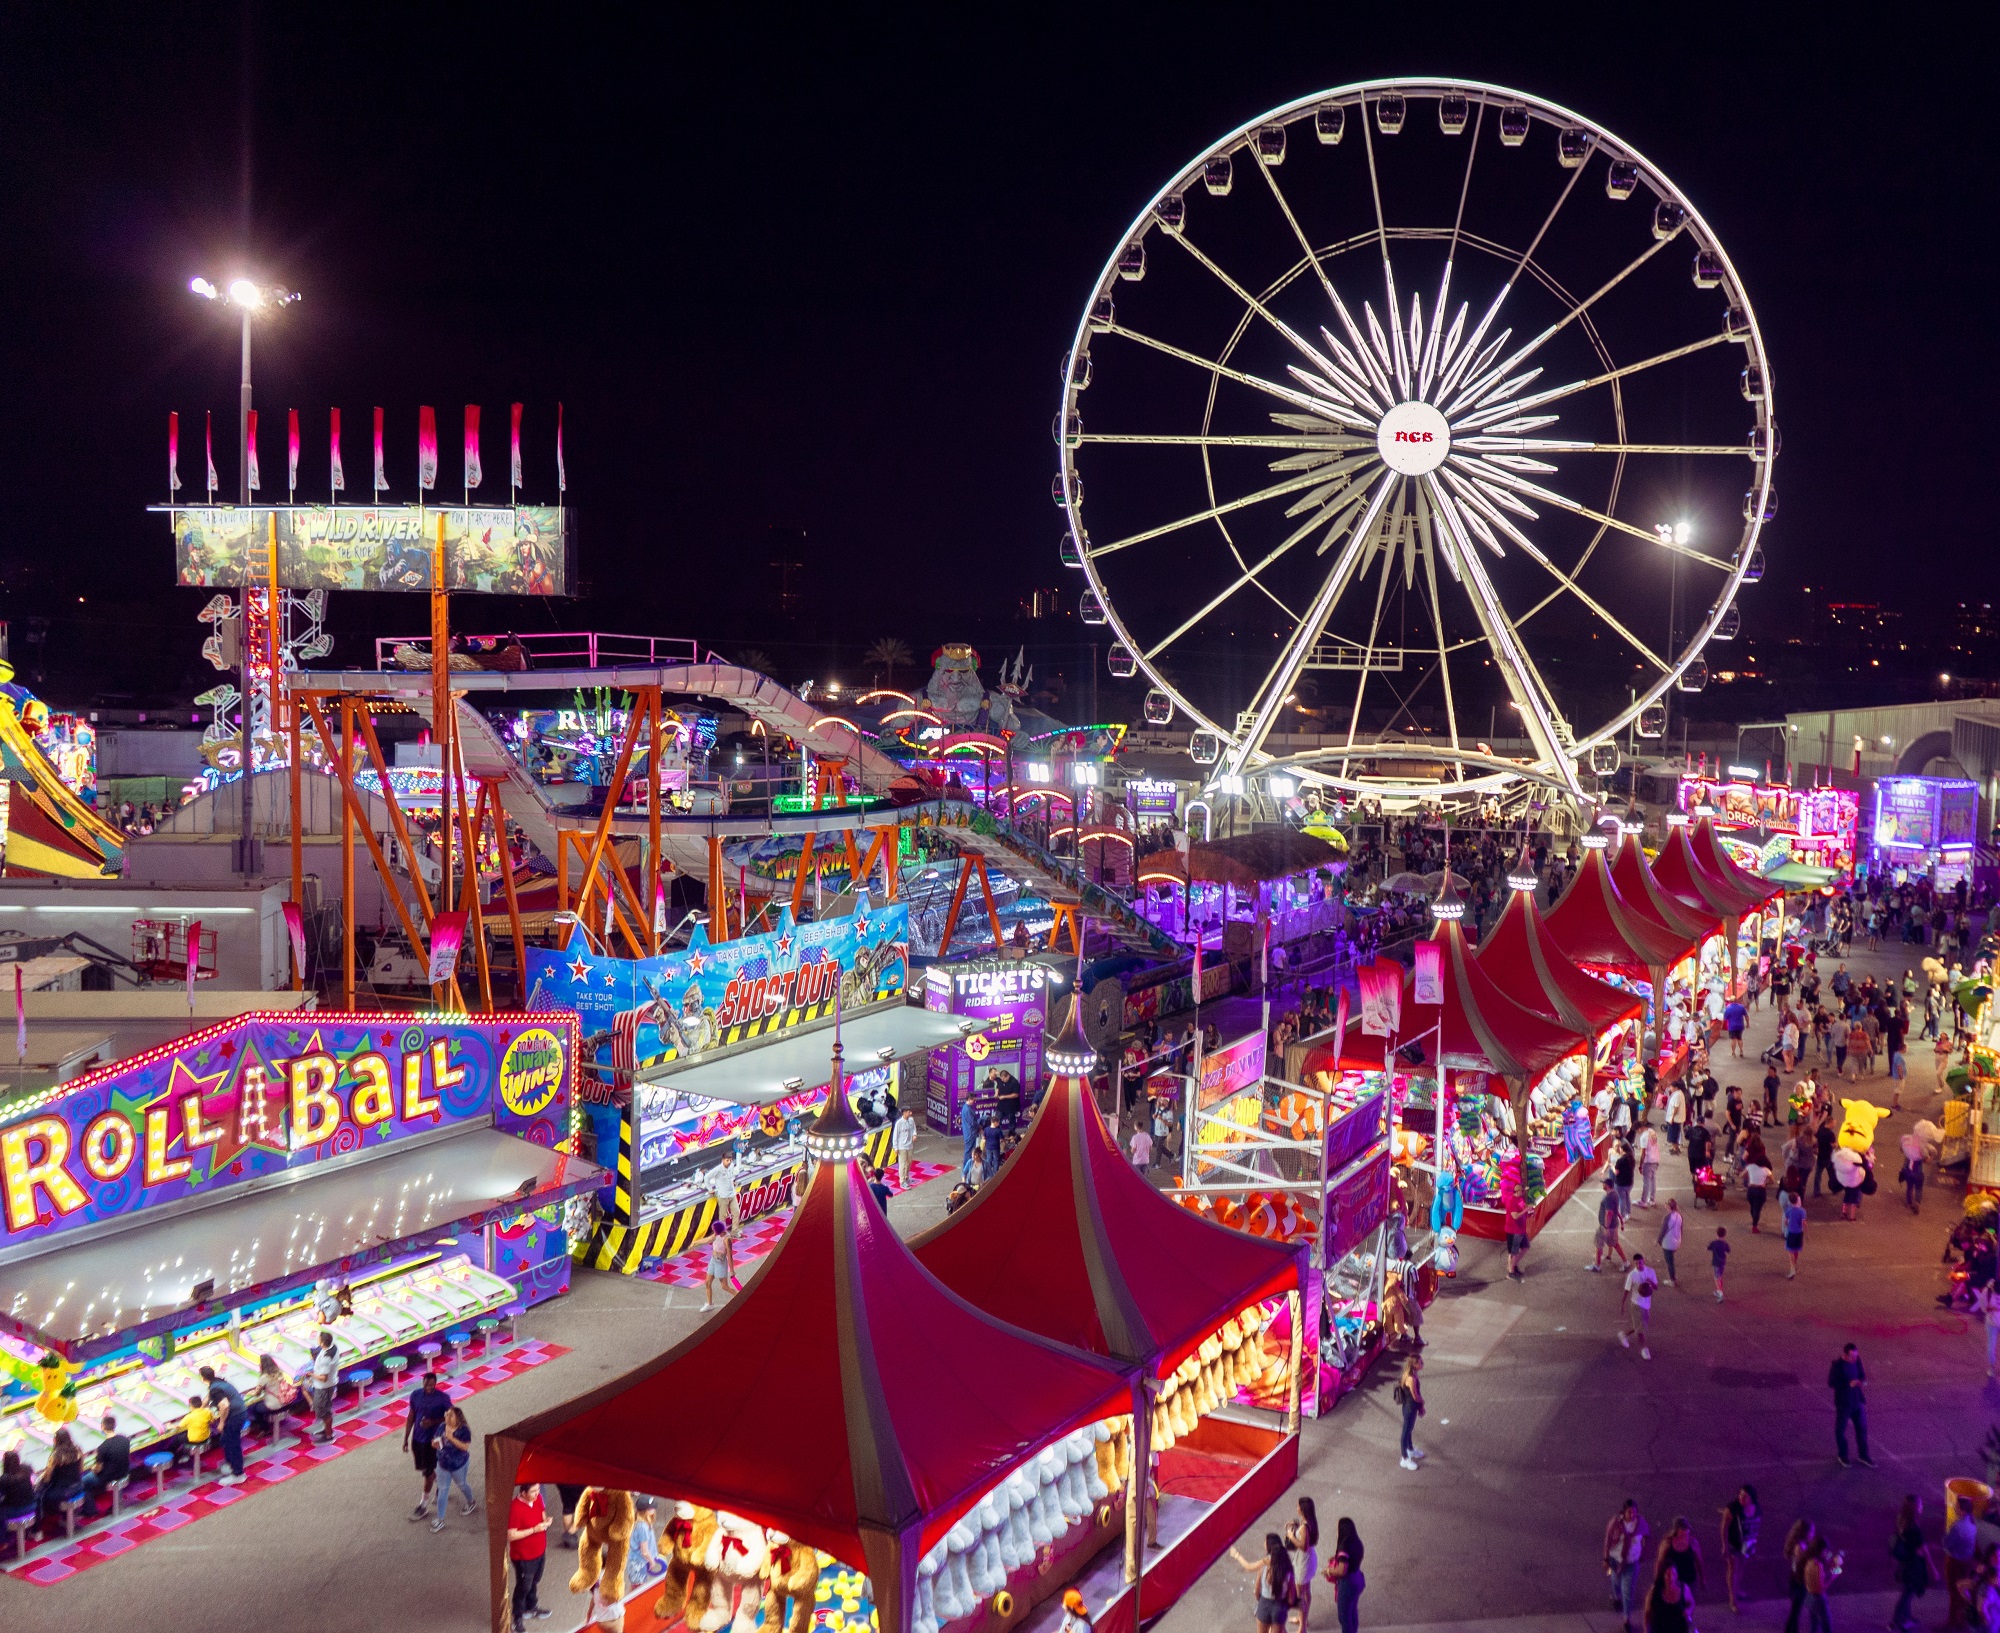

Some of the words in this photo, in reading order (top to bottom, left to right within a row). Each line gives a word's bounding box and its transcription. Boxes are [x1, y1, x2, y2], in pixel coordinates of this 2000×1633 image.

[310, 512, 358, 542] WILD
[360, 512, 421, 542] RIVER
[492, 512, 512, 526] HERE!
[337, 545, 350, 559] THE
[354, 544, 377, 559] RIDE!
[1891, 796, 1927, 808] TREATS
[776, 853, 816, 880] WID
[803, 930, 824, 943] BEST
[825, 923, 849, 940] SHOT!
[716, 949, 740, 963] TAKE
[742, 943, 765, 957] YOUR
[956, 968, 1045, 995] TICKETS
[576, 992, 592, 1000] TAKE
[594, 993, 613, 1001] YOUR
[721, 970, 797, 1029] SHOOT
[795, 958, 840, 1009] OUT
[965, 995, 993, 1007] RIDES
[1003, 993, 1035, 1005] MES
[576, 1001, 592, 1010] BEST
[595, 1003, 615, 1011] SHOT!
[509, 1048, 558, 1074] Always
[582, 1078, 614, 1105] OUT
[927, 1097, 948, 1116] TICKETS
[0, 1092, 226, 1233] ROLL
[235, 1065, 271, 1146] A
